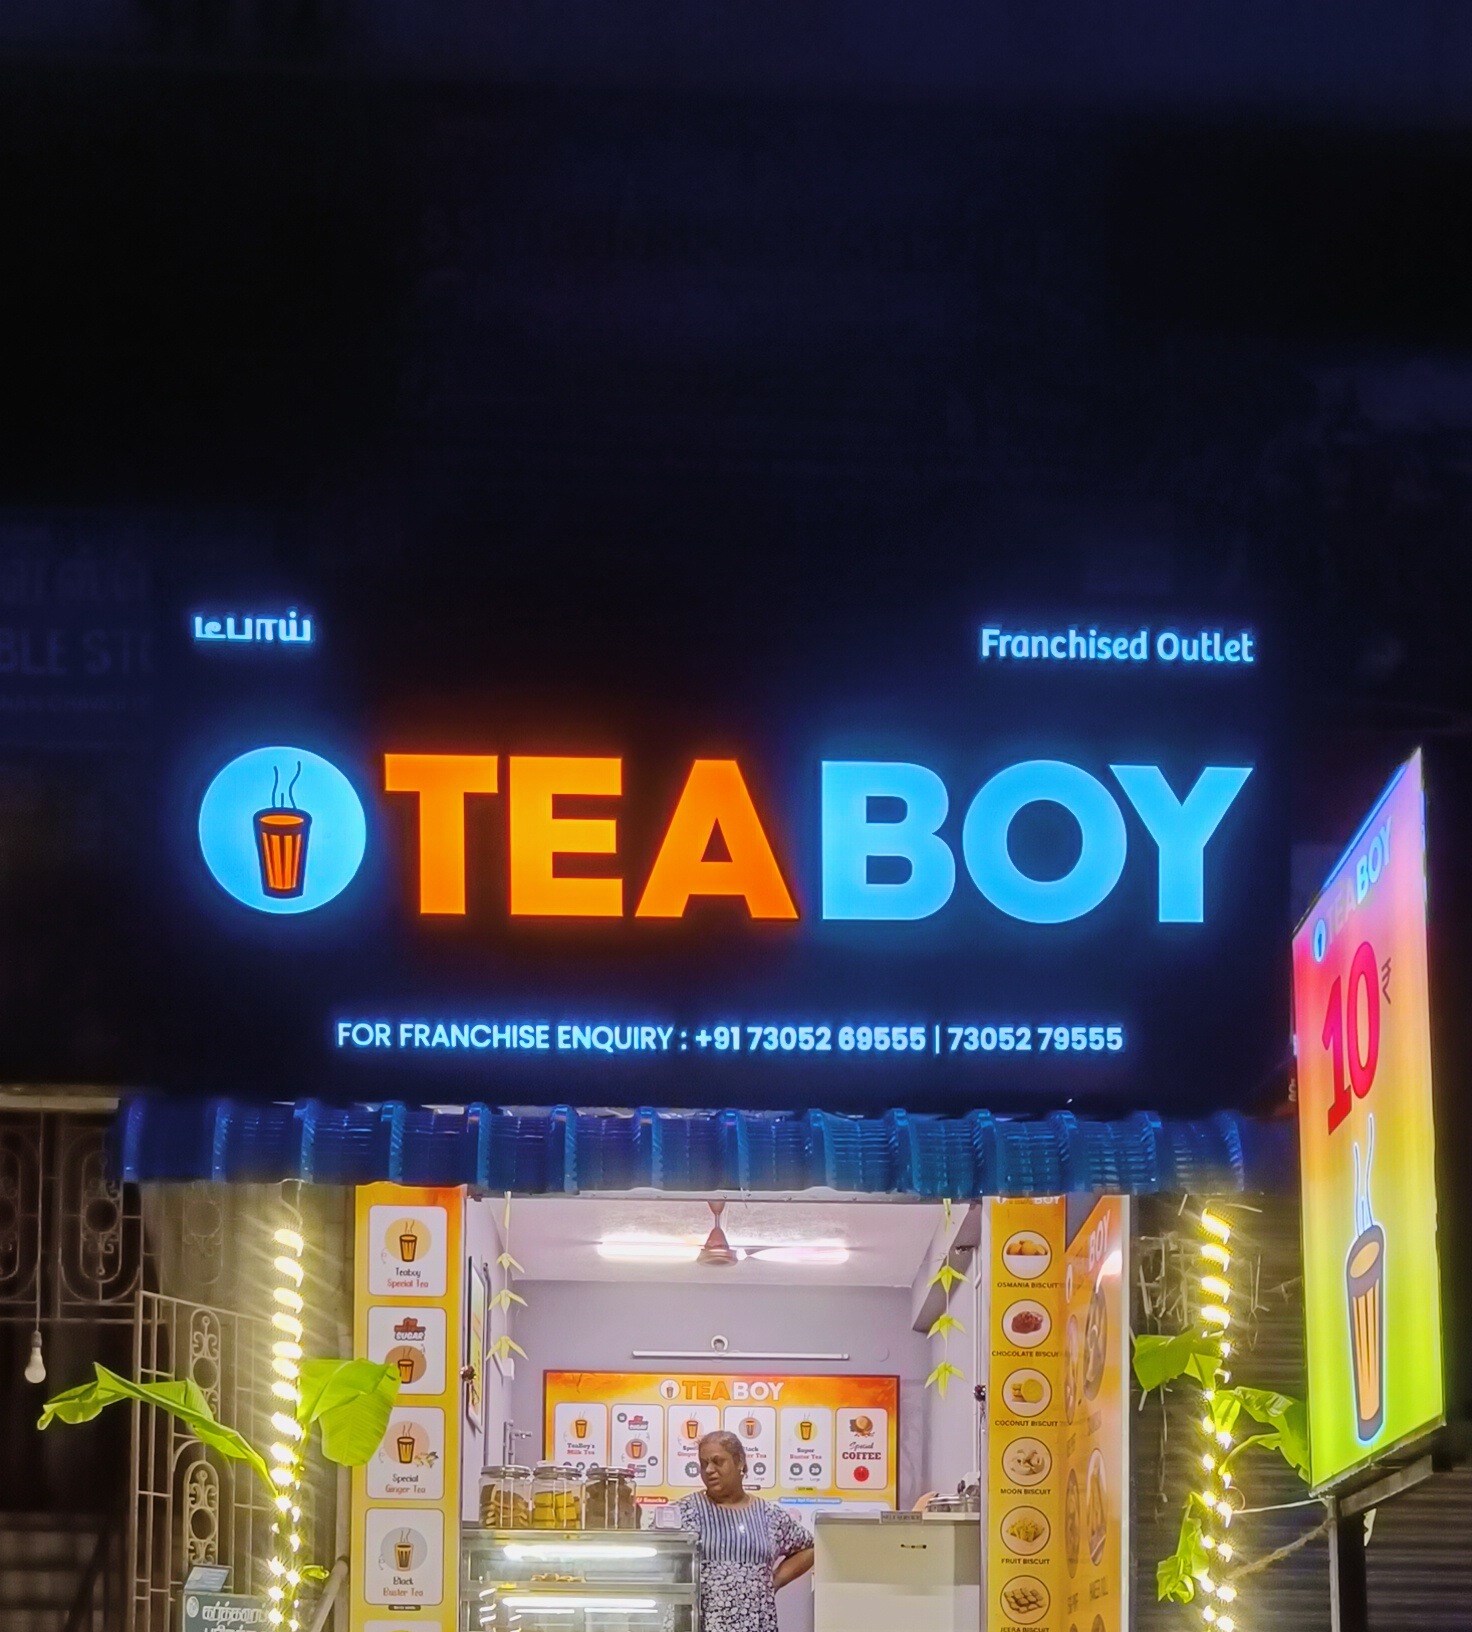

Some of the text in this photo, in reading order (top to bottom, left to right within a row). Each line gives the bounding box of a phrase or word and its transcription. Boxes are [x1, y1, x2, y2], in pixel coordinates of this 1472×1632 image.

[981, 628, 1254, 662] Franchised Outlet
[337, 1023, 391, 1048] FOR
[399, 1024, 550, 1049] FRANCHISE
[557, 1025, 674, 1052] ENQUIRY
[695, 1026, 740, 1051] +91
[747, 1026, 832, 1051] 73052
[837, 1026, 926, 1051] 69555
[947, 1027, 1031, 1051] 73052
[1037, 1027, 1123, 1052] 79555
[1321, 940, 1380, 1136] 10
[395, 1267, 421, 1279] Teaboy
[386, 1278, 429, 1289] Special Tea
[996, 1281, 1030, 1289] OSMANIA
[841, 1451, 881, 1460] COFFEE
[392, 1473, 419, 1484] Special
[385, 1484, 426, 1495] Ginger Tea
[393, 1576, 414, 1585] Black
[410, 1587, 424, 1596] Tea
